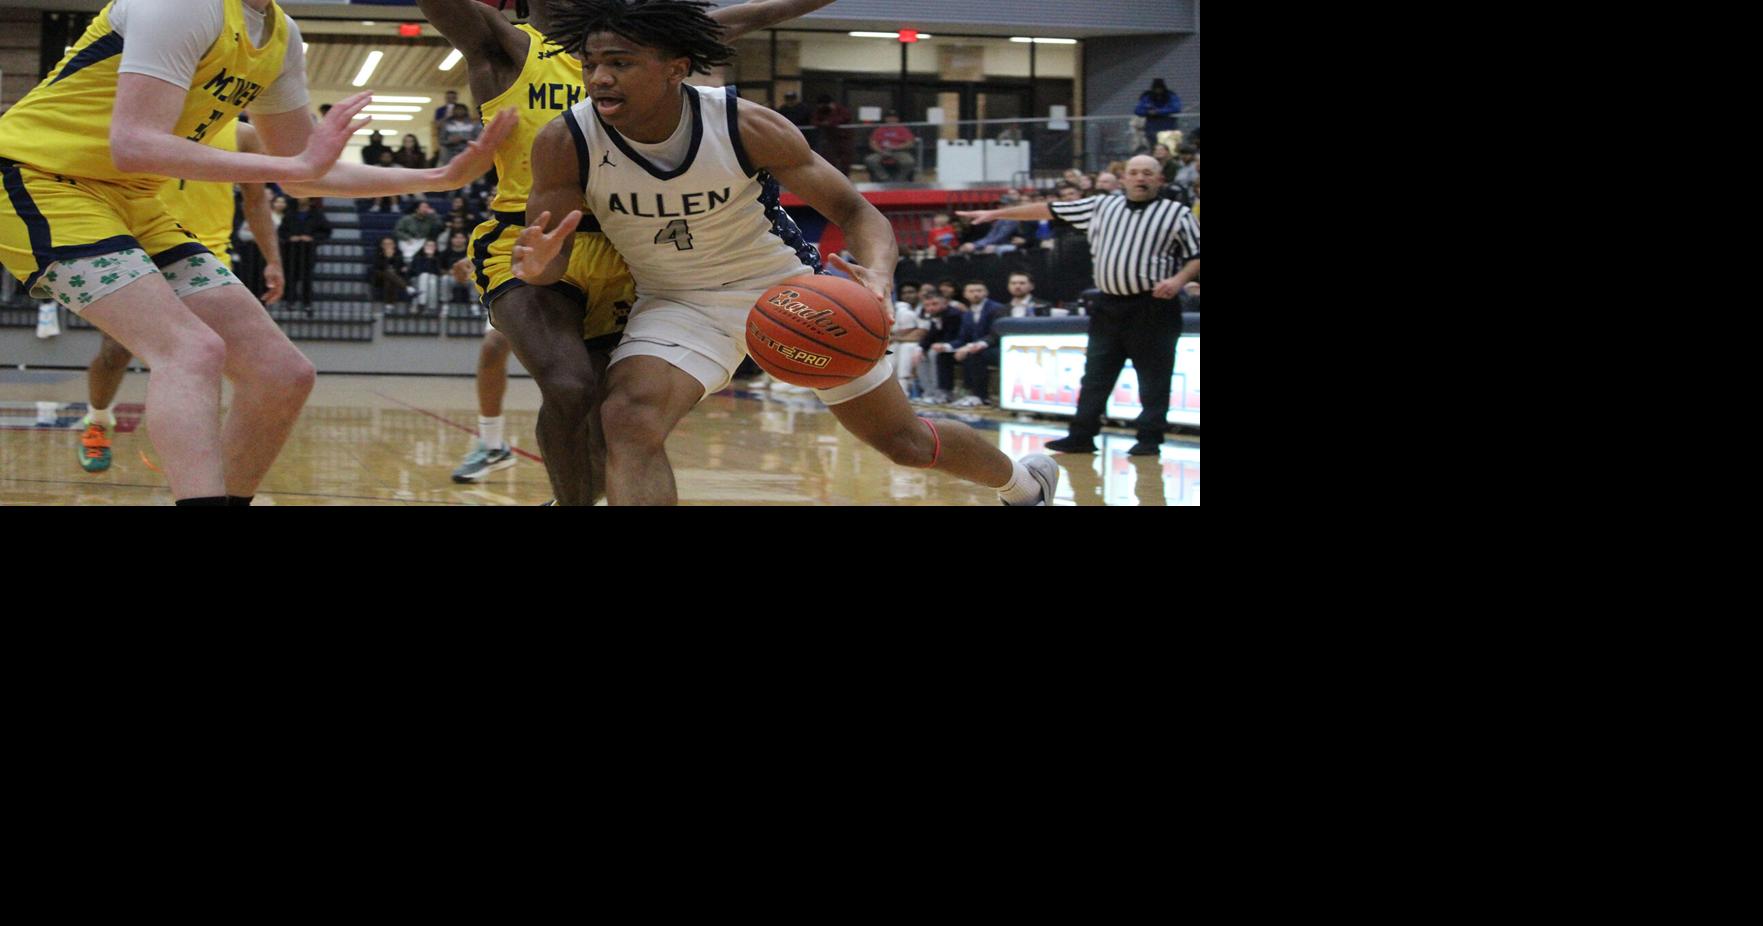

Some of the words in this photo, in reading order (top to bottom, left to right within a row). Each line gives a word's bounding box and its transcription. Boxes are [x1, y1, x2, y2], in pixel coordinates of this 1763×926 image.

[609, 187, 730, 218] ALLEN
[653, 219, 693, 251] 4
[768, 289, 848, 338] Baden
[793, 349, 829, 367] PRO
